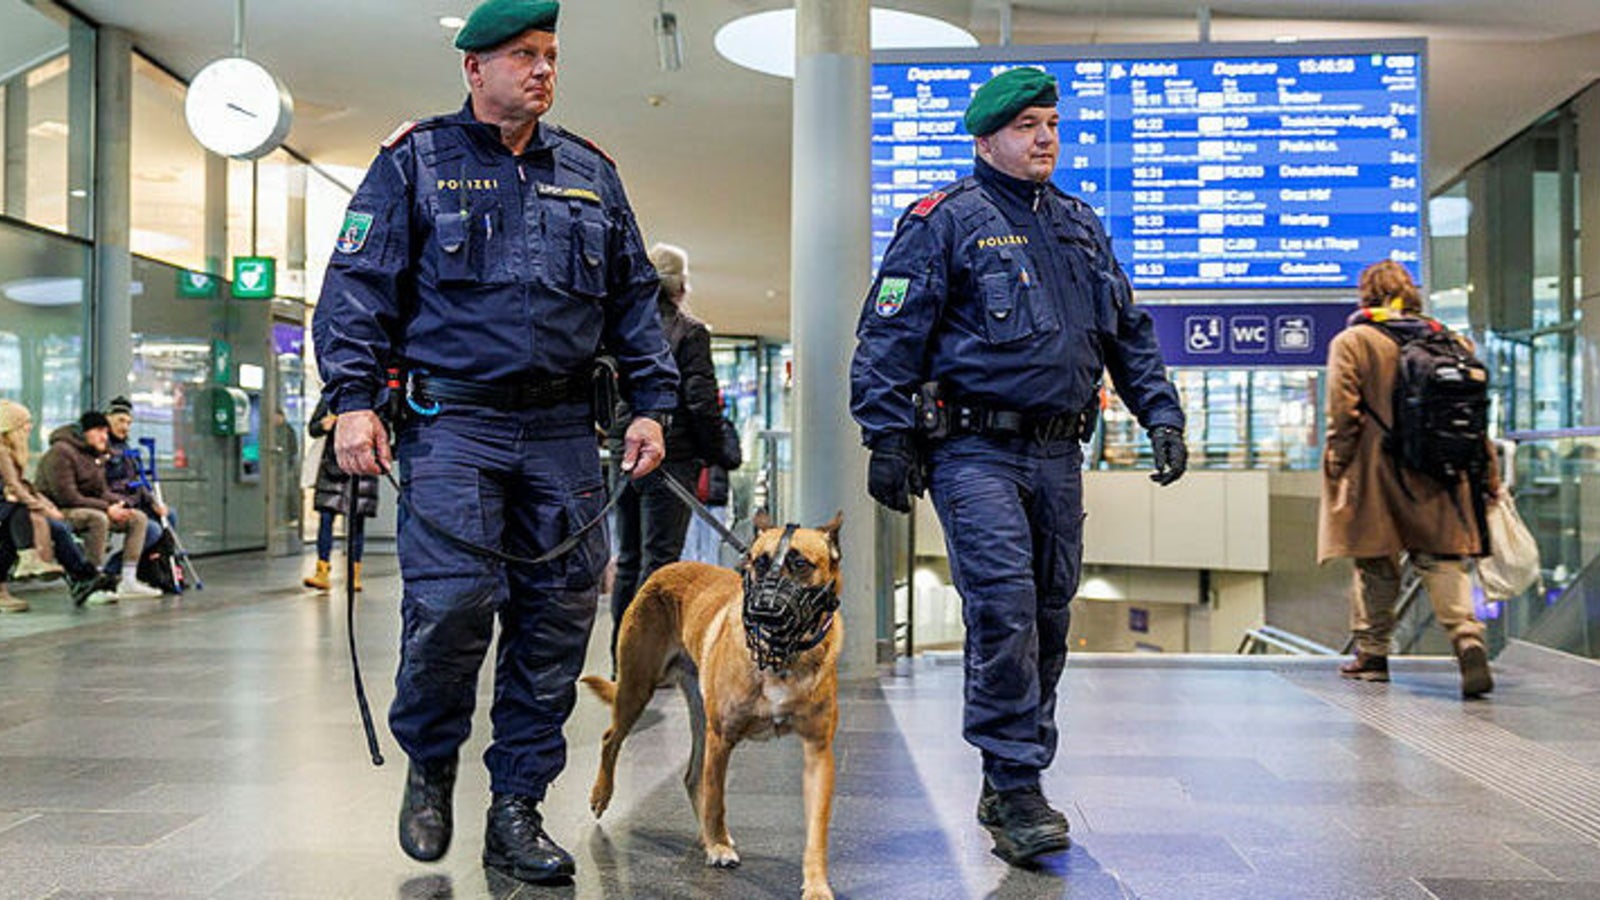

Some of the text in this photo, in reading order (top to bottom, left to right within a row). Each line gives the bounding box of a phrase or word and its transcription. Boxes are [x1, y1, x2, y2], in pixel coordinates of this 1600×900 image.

[908, 67, 971, 82] Departure
[1212, 62, 1278, 77] Departure
[977, 235, 1029, 249] POLIZEI
[1233, 326, 1266, 343] WC
